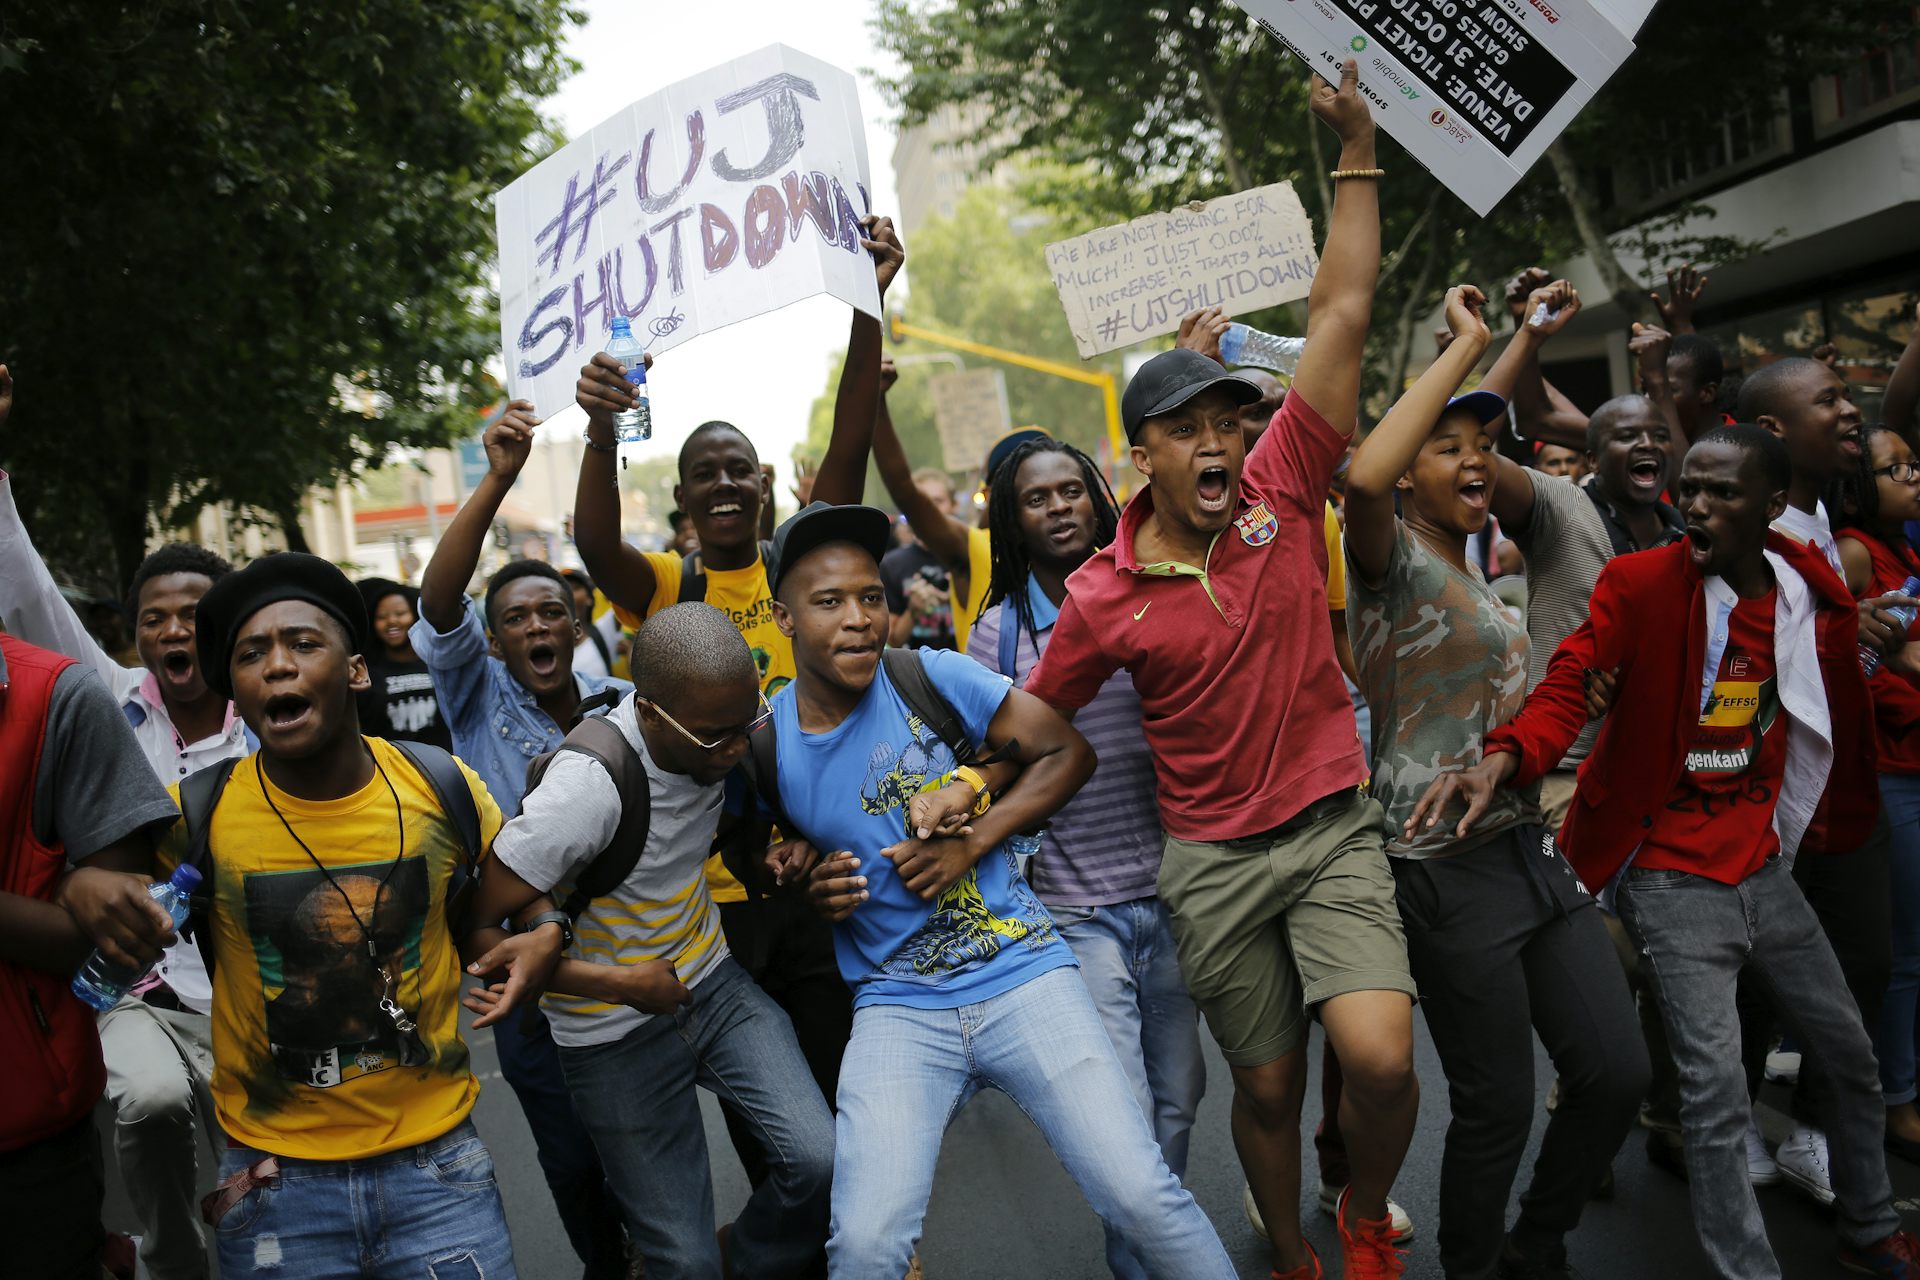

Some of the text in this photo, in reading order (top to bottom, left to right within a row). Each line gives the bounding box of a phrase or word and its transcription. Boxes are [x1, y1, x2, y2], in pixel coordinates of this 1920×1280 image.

[1312, 0, 1334, 21] KENA
[1428, 0, 1509, 65] GATES OP
[1479, 6, 1528, 51] SHOW
[1374, 16, 1443, 80] TICKET
[1445, 38, 1474, 67] 31
[1320, 51, 1388, 109] SPONSD BY
[1474, 62, 1534, 121] DATE:
[1443, 122, 1467, 143] SABC
[1446, 75, 1511, 142] VENUE:
[535, 72, 820, 278] #UJ
[1052, 195, 1277, 265] WE ARE NOT ASKING FOR
[1143, 238, 1201, 268] JUST
[1096, 255, 1316, 342] #UJSHUTDOWN
[736, 619, 758, 631] ONS
[1723, 697, 1757, 707] EFFSC
[367, 1062, 385, 1073] ANC
